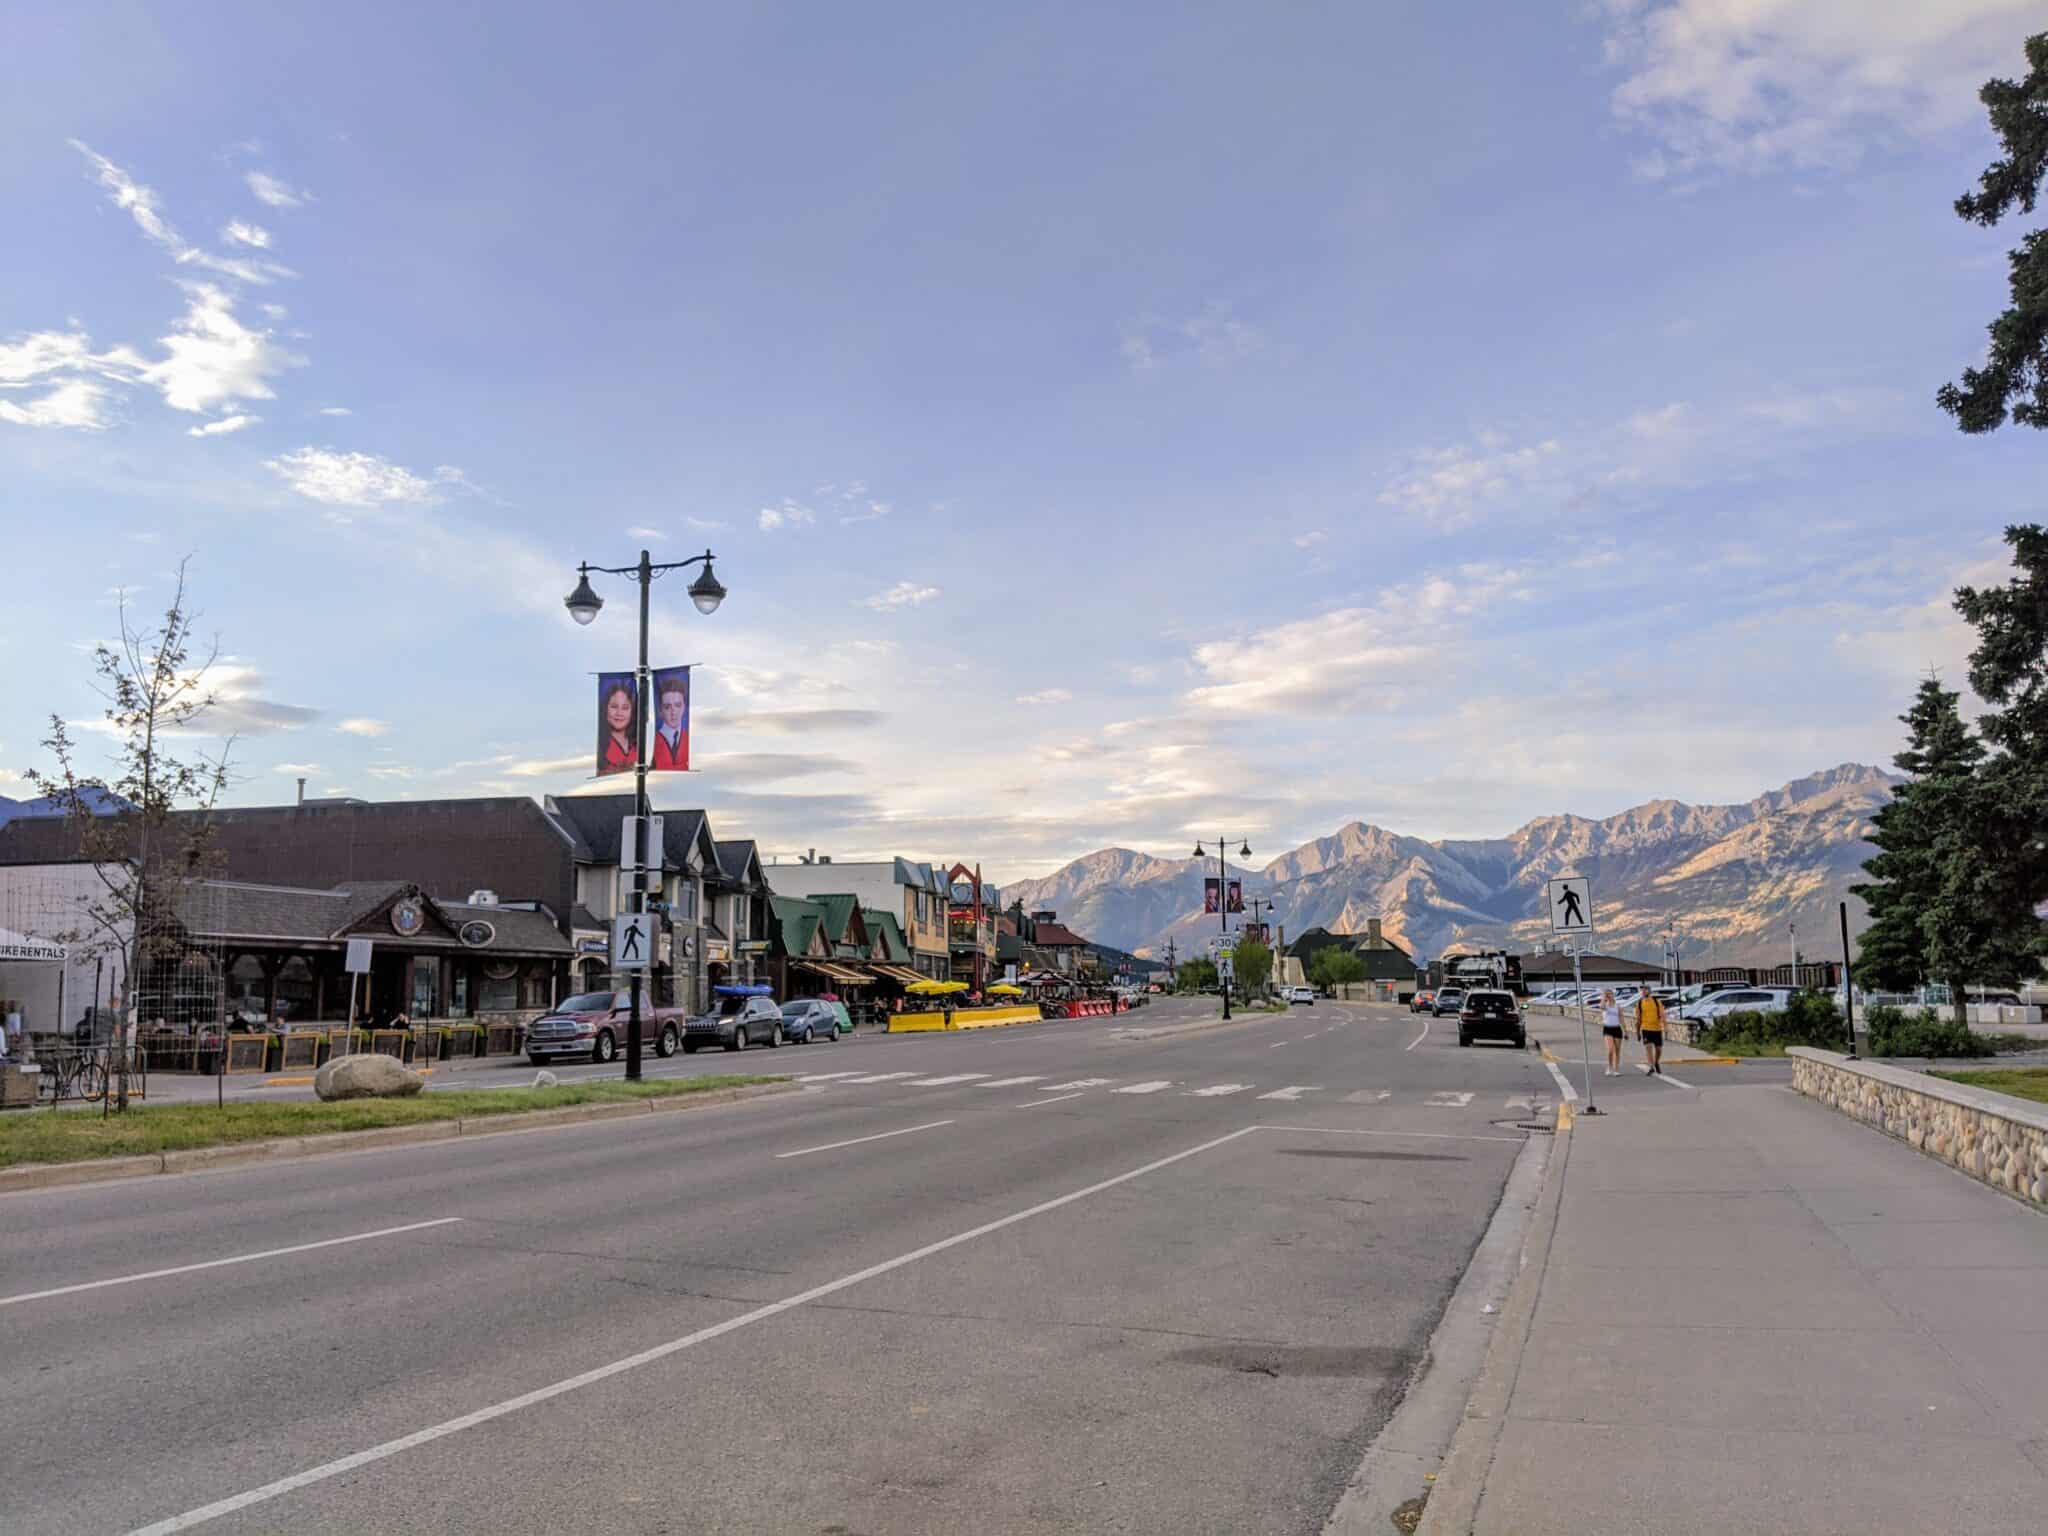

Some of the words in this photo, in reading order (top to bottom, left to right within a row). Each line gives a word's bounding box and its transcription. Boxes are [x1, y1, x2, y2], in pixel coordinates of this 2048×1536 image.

[1219, 938, 1231, 948] 30
[0, 945, 19, 957] IKE
[20, 946, 65, 959] RENTALS
